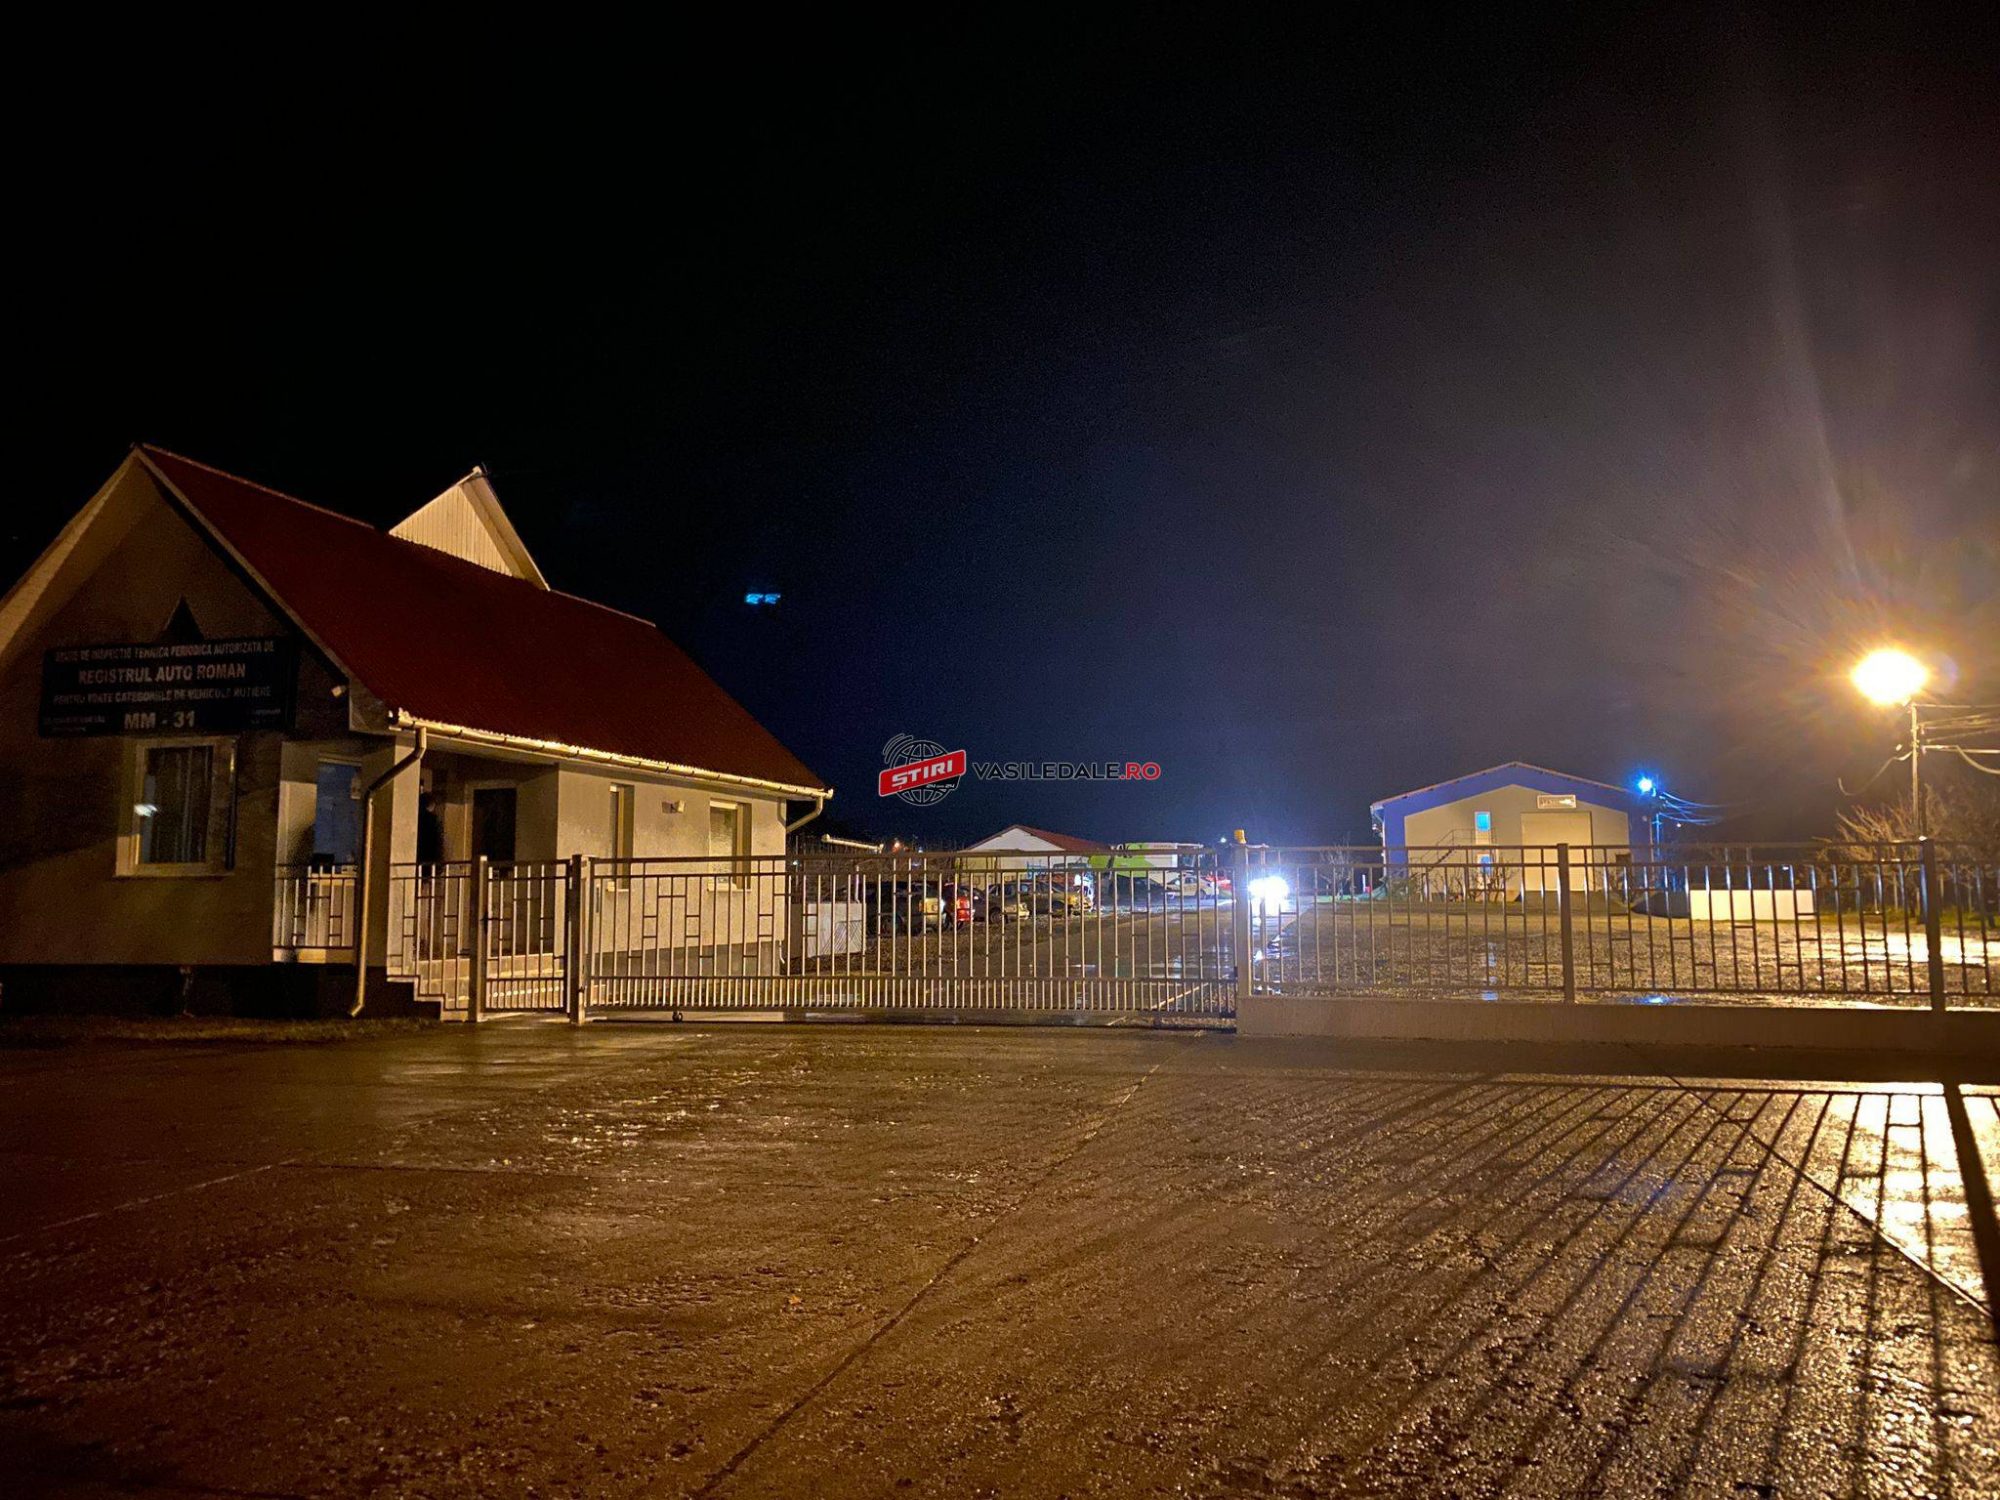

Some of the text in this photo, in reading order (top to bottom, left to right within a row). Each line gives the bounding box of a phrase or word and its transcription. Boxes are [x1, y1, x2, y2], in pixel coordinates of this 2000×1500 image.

[78, 663, 246, 685] REGISTRUL AUTO ROMAN
[115, 689, 171, 703] CATEGOLE
[124, 712, 156, 729] MM
[173, 710, 195, 728] 31
